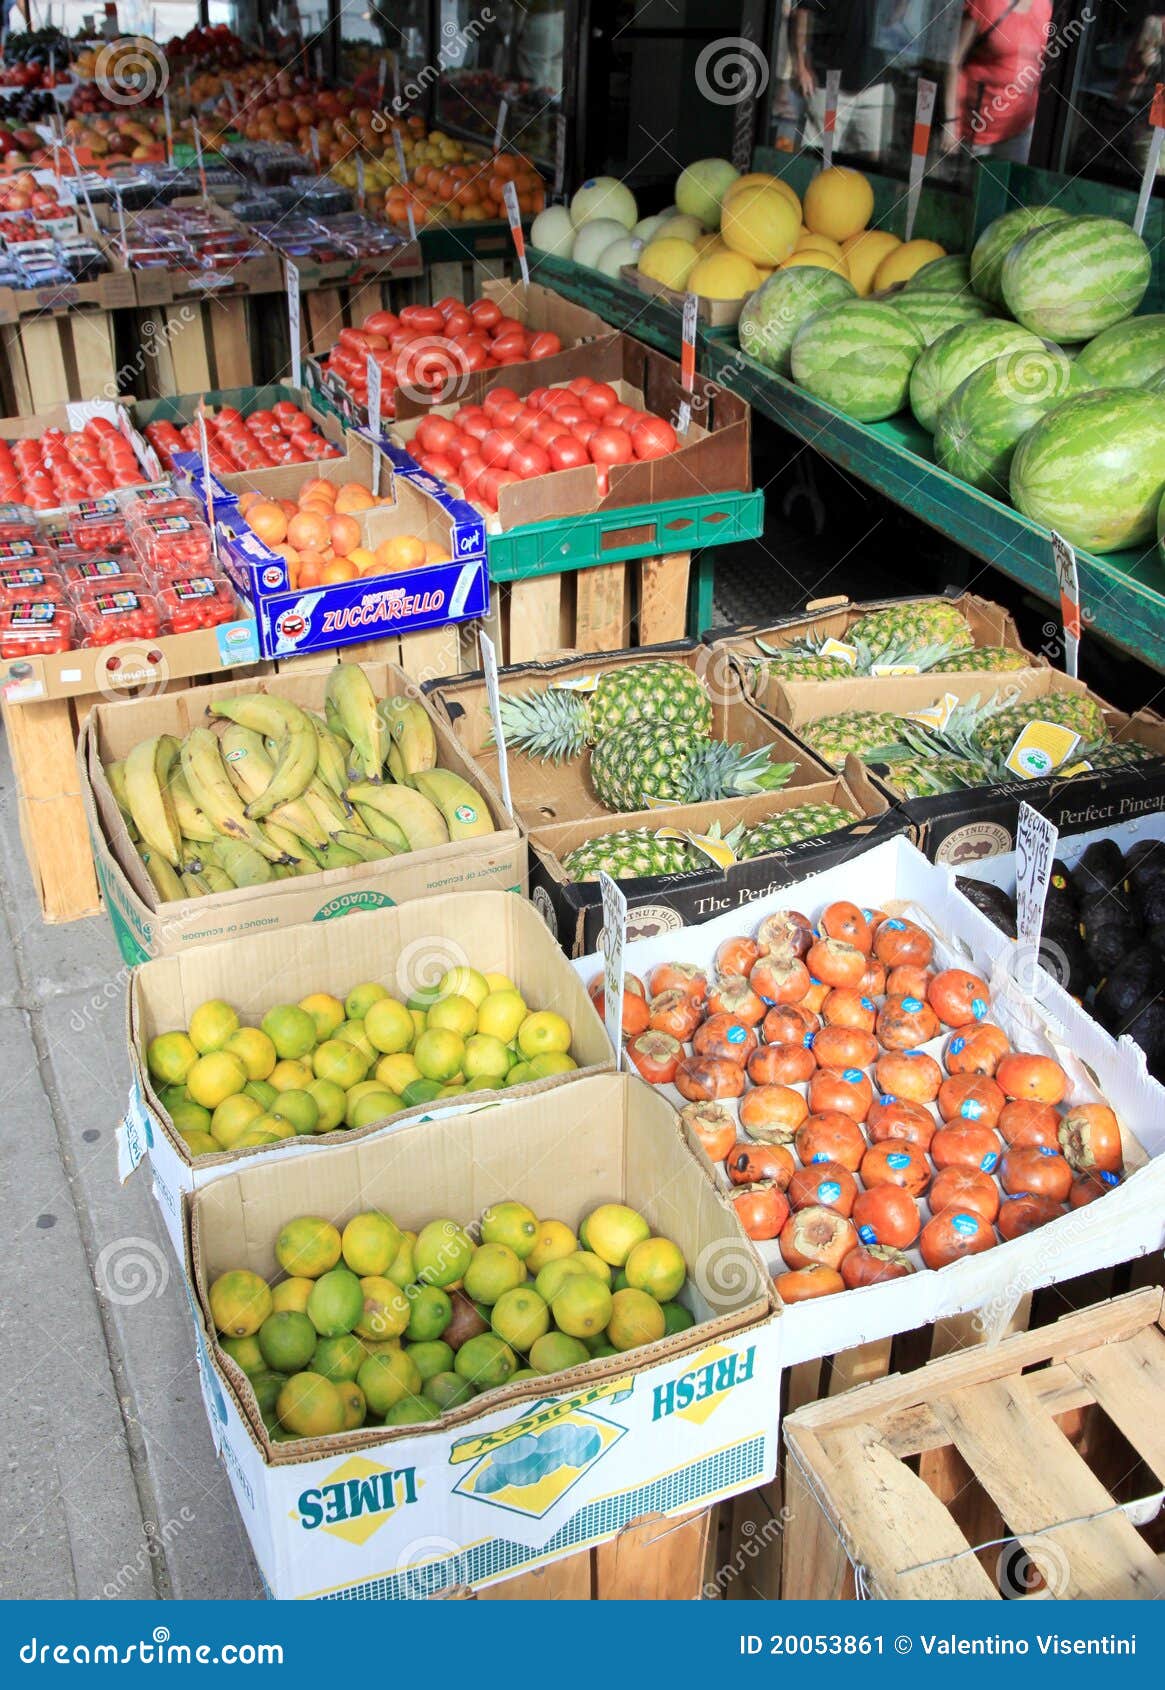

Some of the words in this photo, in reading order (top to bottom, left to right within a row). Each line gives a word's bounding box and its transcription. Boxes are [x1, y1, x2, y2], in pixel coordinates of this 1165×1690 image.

[322, 590, 445, 633] ZUCCARELLO
[1059, 804, 1113, 827] Perfect
[1119, 793, 1165, 815] Pineap
[1018, 803, 1052, 844] SPECIAL
[797, 837, 832, 850] The
[939, 825, 990, 857] CHESTNUT
[993, 826, 1013, 850] HILL
[466, 872, 476, 881] OF
[477, 863, 513, 877] PRODUCT
[662, 868, 718, 883] eapple
[426, 875, 464, 889] ECUADOR
[321, 892, 385, 917] ECUADOR
[694, 896, 730, 916] The
[738, 879, 798, 905] Perfe
[226, 924, 238, 933] OF
[239, 916, 280, 930] PRODUCT
[628, 908, 658, 921] TNUT
[659, 907, 680, 930] HILL
[181, 927, 224, 941] ECUADOR
[651, 1344, 757, 1422] FRESH
[297, 1466, 418, 1530] LIMES
